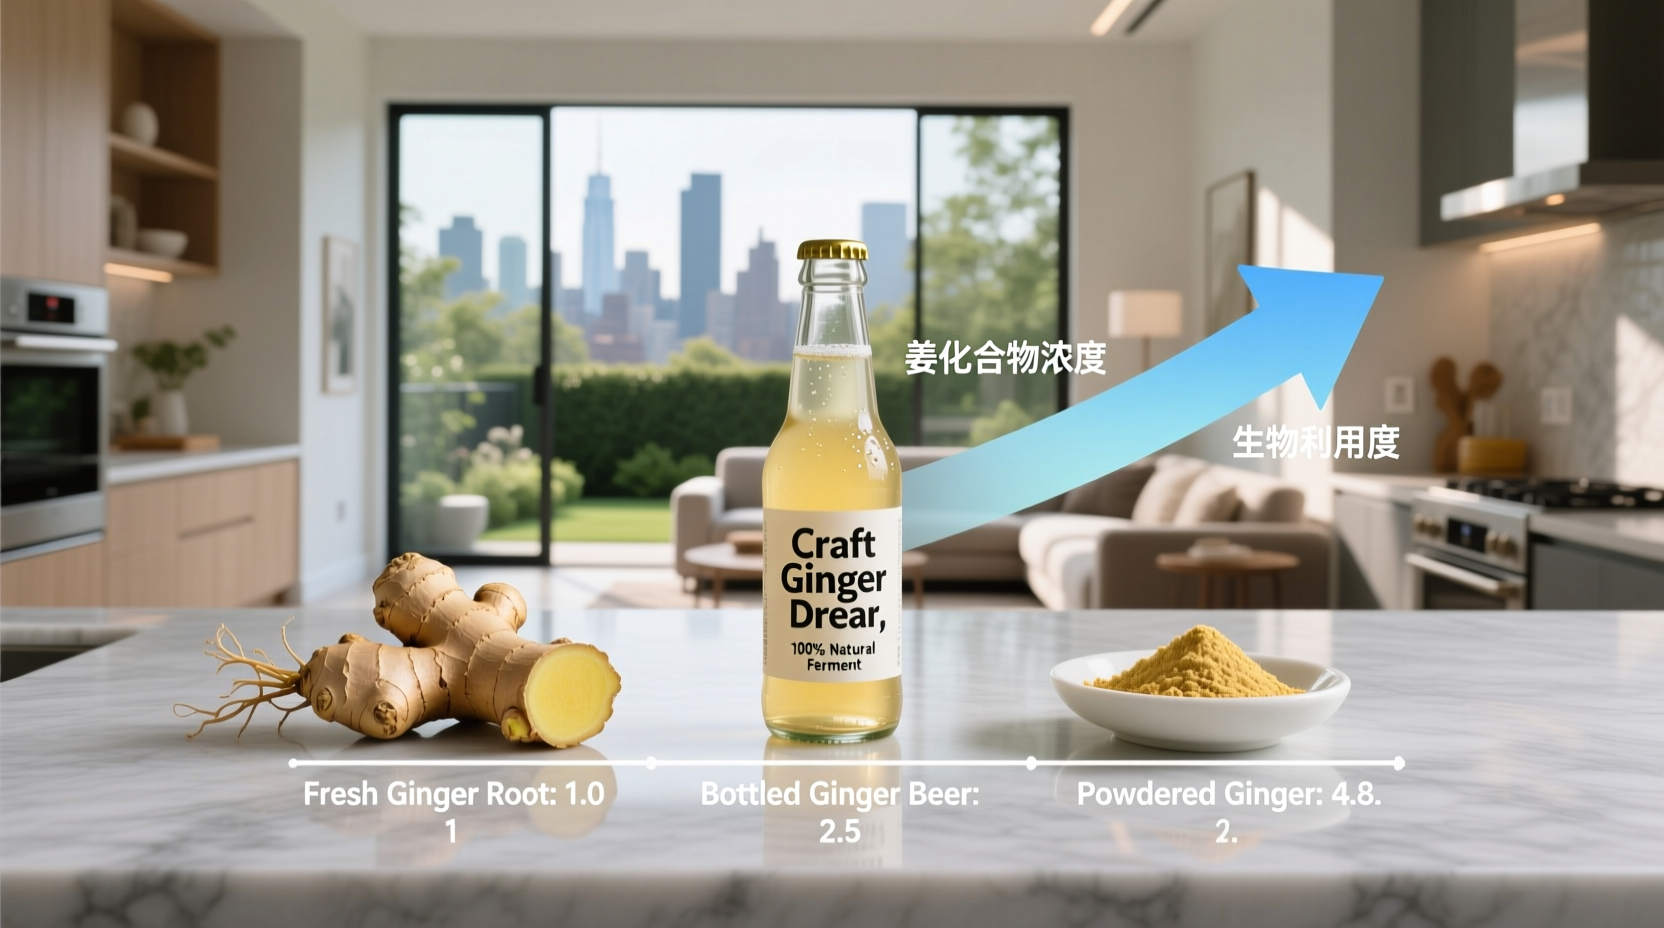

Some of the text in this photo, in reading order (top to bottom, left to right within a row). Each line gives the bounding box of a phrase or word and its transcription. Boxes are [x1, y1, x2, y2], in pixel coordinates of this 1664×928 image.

[791, 527, 876, 559] Craft
[781, 562, 887, 604] Ginger
[790, 598, 886, 634] Drear,
[791, 640, 876, 656] 100% Natural
[807, 658, 862, 672] Ferment
